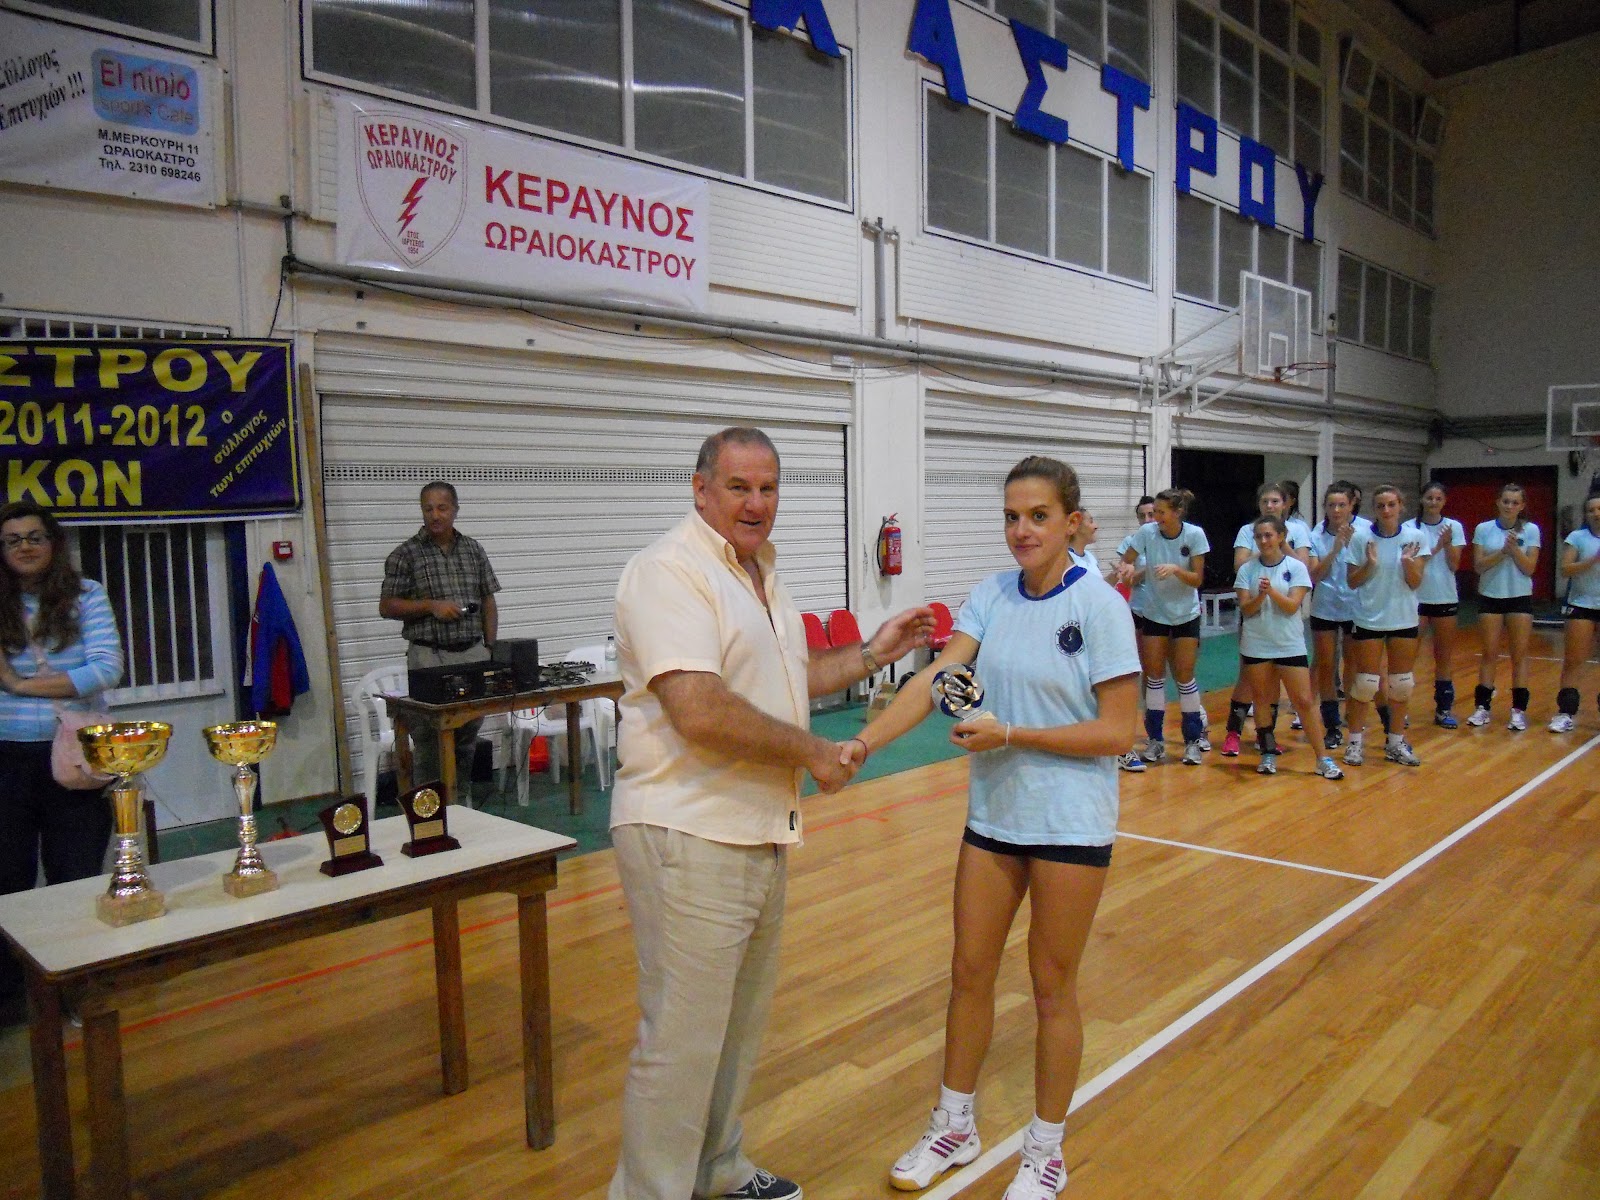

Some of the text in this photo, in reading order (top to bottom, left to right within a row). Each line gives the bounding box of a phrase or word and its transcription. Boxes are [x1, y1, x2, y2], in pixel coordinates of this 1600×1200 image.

[101, 60, 122, 87] El
[103, 144, 195, 168] ΩΡΑΙΟΚΑΣΤΡΟ
[187, 144, 199, 155] 11
[364, 124, 459, 164] ΚΕΡΑΥΝΟΣ
[99, 157, 201, 182] Τηλ. 2310 698246
[366, 150, 457, 185] ΩΡΑΙΟΚΑΣΤΡΟΥ
[485, 165, 695, 243] ΚΕΡΑΥΝΟΣ
[485, 221, 696, 281] ΩΡΑΙΟΚΑΣΤΡΟΥ
[0, 401, 208, 447] 2011-2012
[214, 409, 268, 464] σύλλογος
[209, 418, 287, 498] των επιτυχιών
[7, 458, 142, 507] ΚΩΝ
